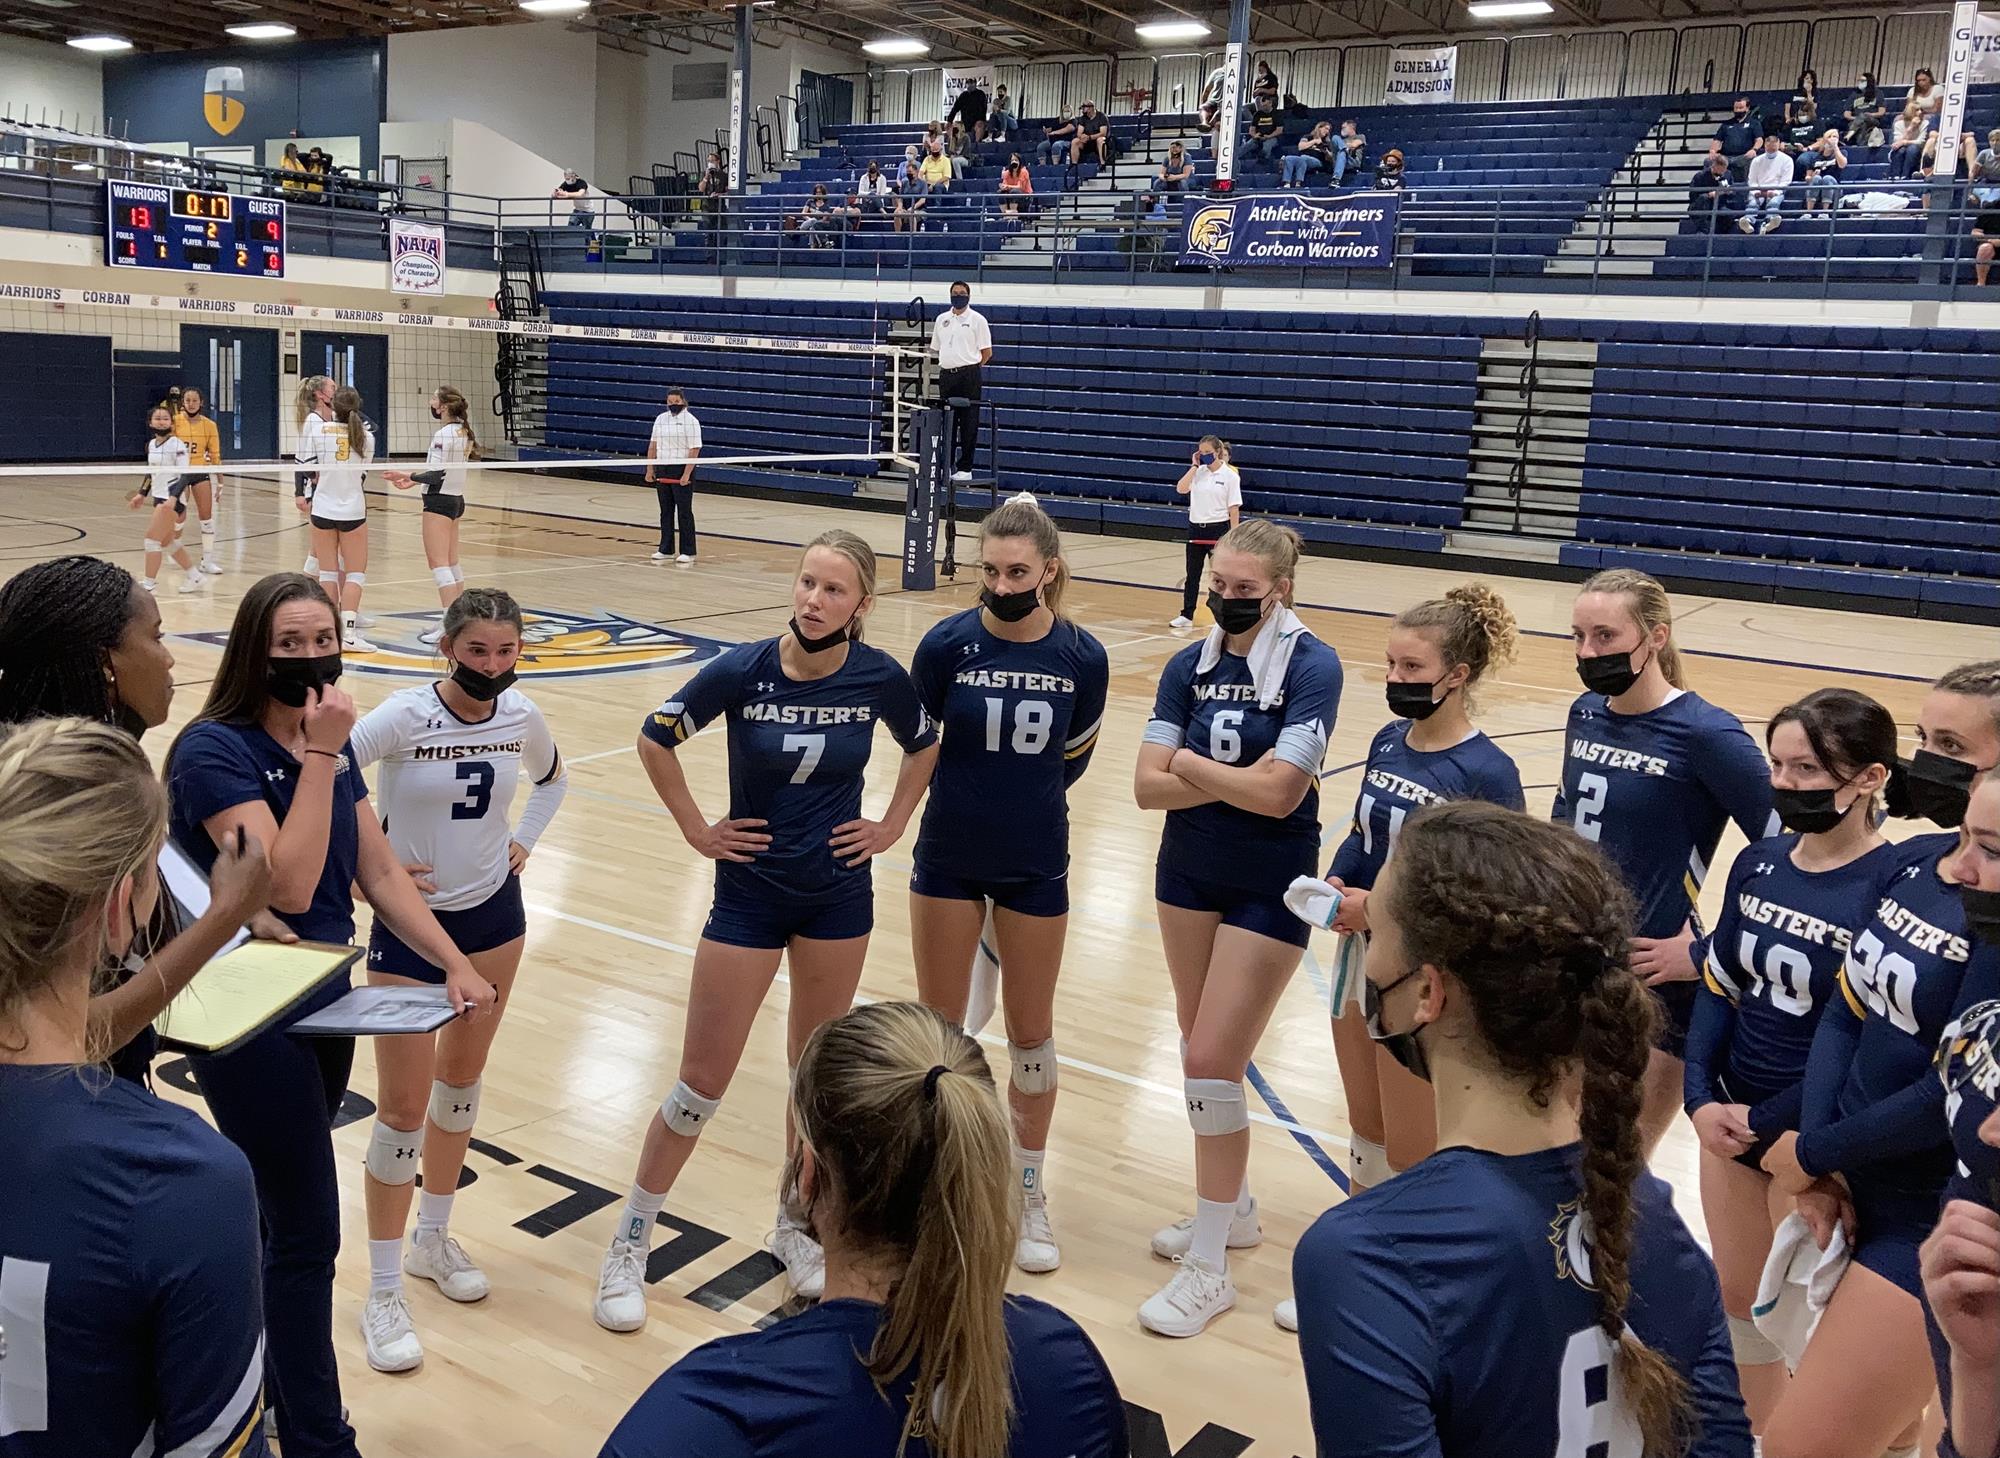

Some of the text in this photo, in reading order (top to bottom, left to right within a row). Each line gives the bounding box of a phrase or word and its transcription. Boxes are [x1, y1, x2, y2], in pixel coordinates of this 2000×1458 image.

[1394, 59, 1448, 73] GENERAL
[1386, 78, 1453, 93] ADMISSION
[1942, 28, 1971, 149] GUESTS
[1220, 52, 1238, 173] FANATICS
[731, 78, 741, 182] WARRIORS
[113, 184, 168, 203] WARRIORS
[186, 193, 228, 217] 0:17
[130, 207, 150, 228] 13
[249, 200, 280, 215] GUEST
[1248, 206, 1384, 223] Athletic Partners
[116, 231, 134, 240] FOULS
[182, 238, 202, 246] PLAYER
[185, 222, 218, 240] PERIOD 2
[266, 221, 279, 240] 9
[1298, 225, 1328, 239] with
[236, 251, 247, 267] 2
[397, 235, 438, 260] NAIA
[1247, 241, 1379, 257] Corban Warriors
[401, 260, 433, 270] Champions
[407, 269, 435, 277] Character
[83, 291, 130, 305] CORBAN
[179, 298, 236, 312] WARRIORS
[253, 303, 294, 316] CORBAN
[335, 309, 384, 322] WARRIORS
[398, 314, 433, 325] CORBAN
[468, 318, 510, 331] WARRIORS
[522, 322, 553, 333] CORBAN
[583, 326, 620, 338] WARRIORS
[630, 329, 657, 340] CORBAN
[683, 333, 715, 344] WARRIORS
[724, 336, 748, 345] CORBAN
[926, 435, 939, 552] WARRIORS
[955, 670, 1075, 693] MASTER'S
[743, 703, 871, 725] MASTER'S
[985, 697, 1054, 755] 18
[1210, 709, 1244, 763] 6
[782, 733, 826, 784] 7
[1570, 738, 1669, 776] MASTER'S
[451, 761, 495, 820] 3
[1574, 771, 1608, 843] 2
[1739, 892, 1853, 953] MASTER'S
[1739, 930, 1813, 1017] 10
[1852, 928, 1920, 1036] 20
